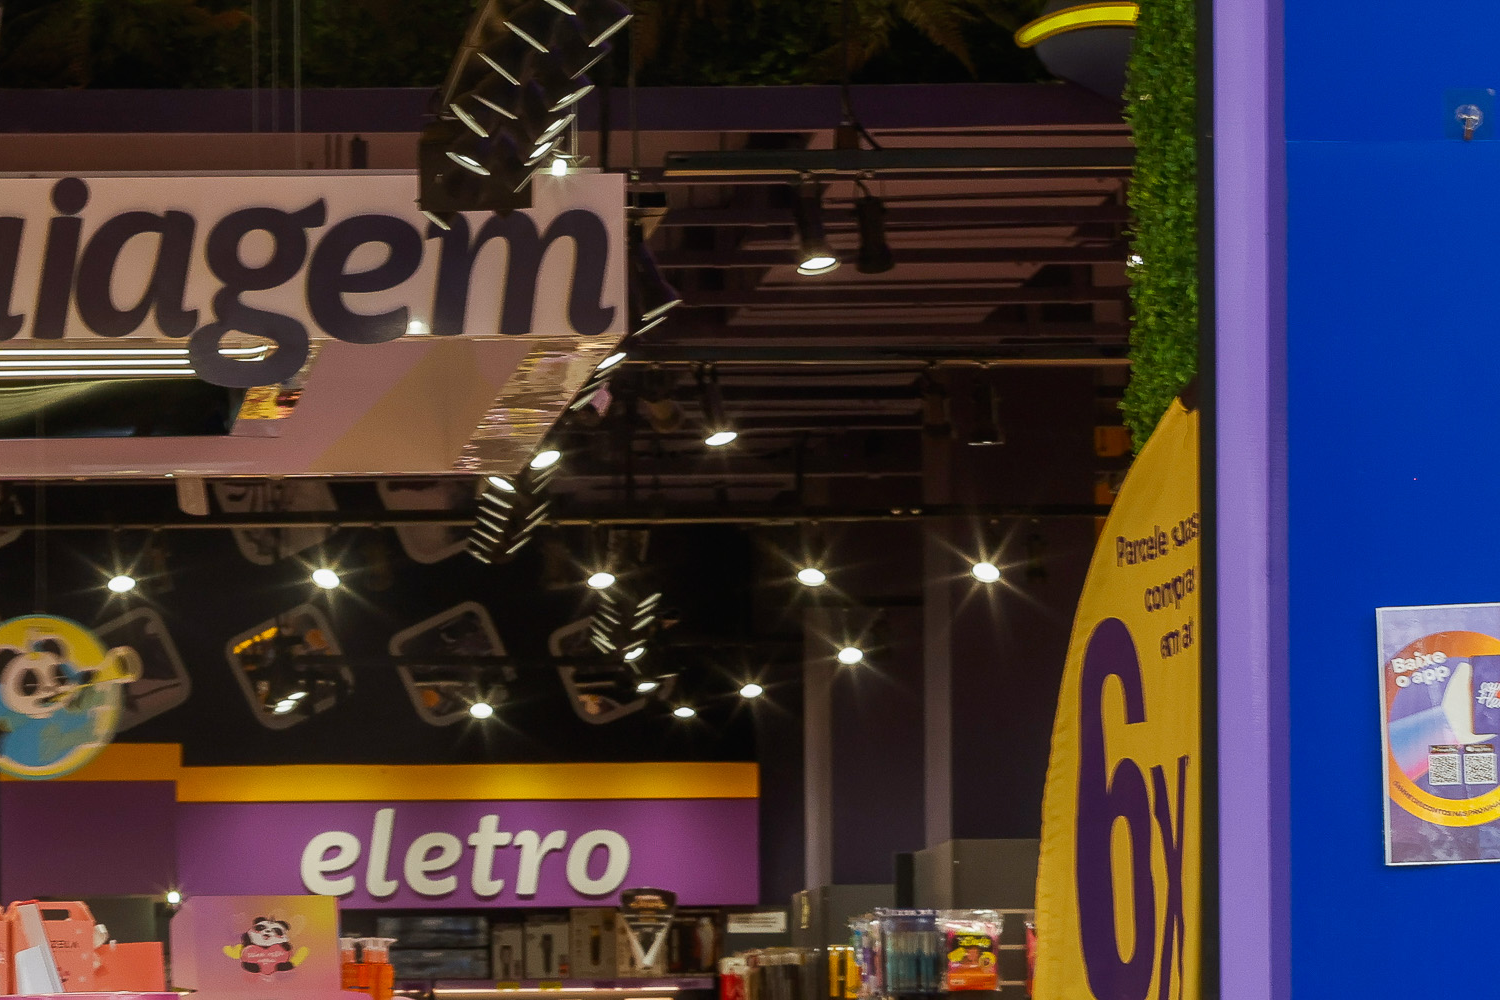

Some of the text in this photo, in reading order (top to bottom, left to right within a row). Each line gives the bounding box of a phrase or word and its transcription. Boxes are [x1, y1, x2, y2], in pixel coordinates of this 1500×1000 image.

[1390, 651, 1448, 674] Baixe
[1395, 665, 1451, 688] o app
[299, 807, 632, 898] eletro
